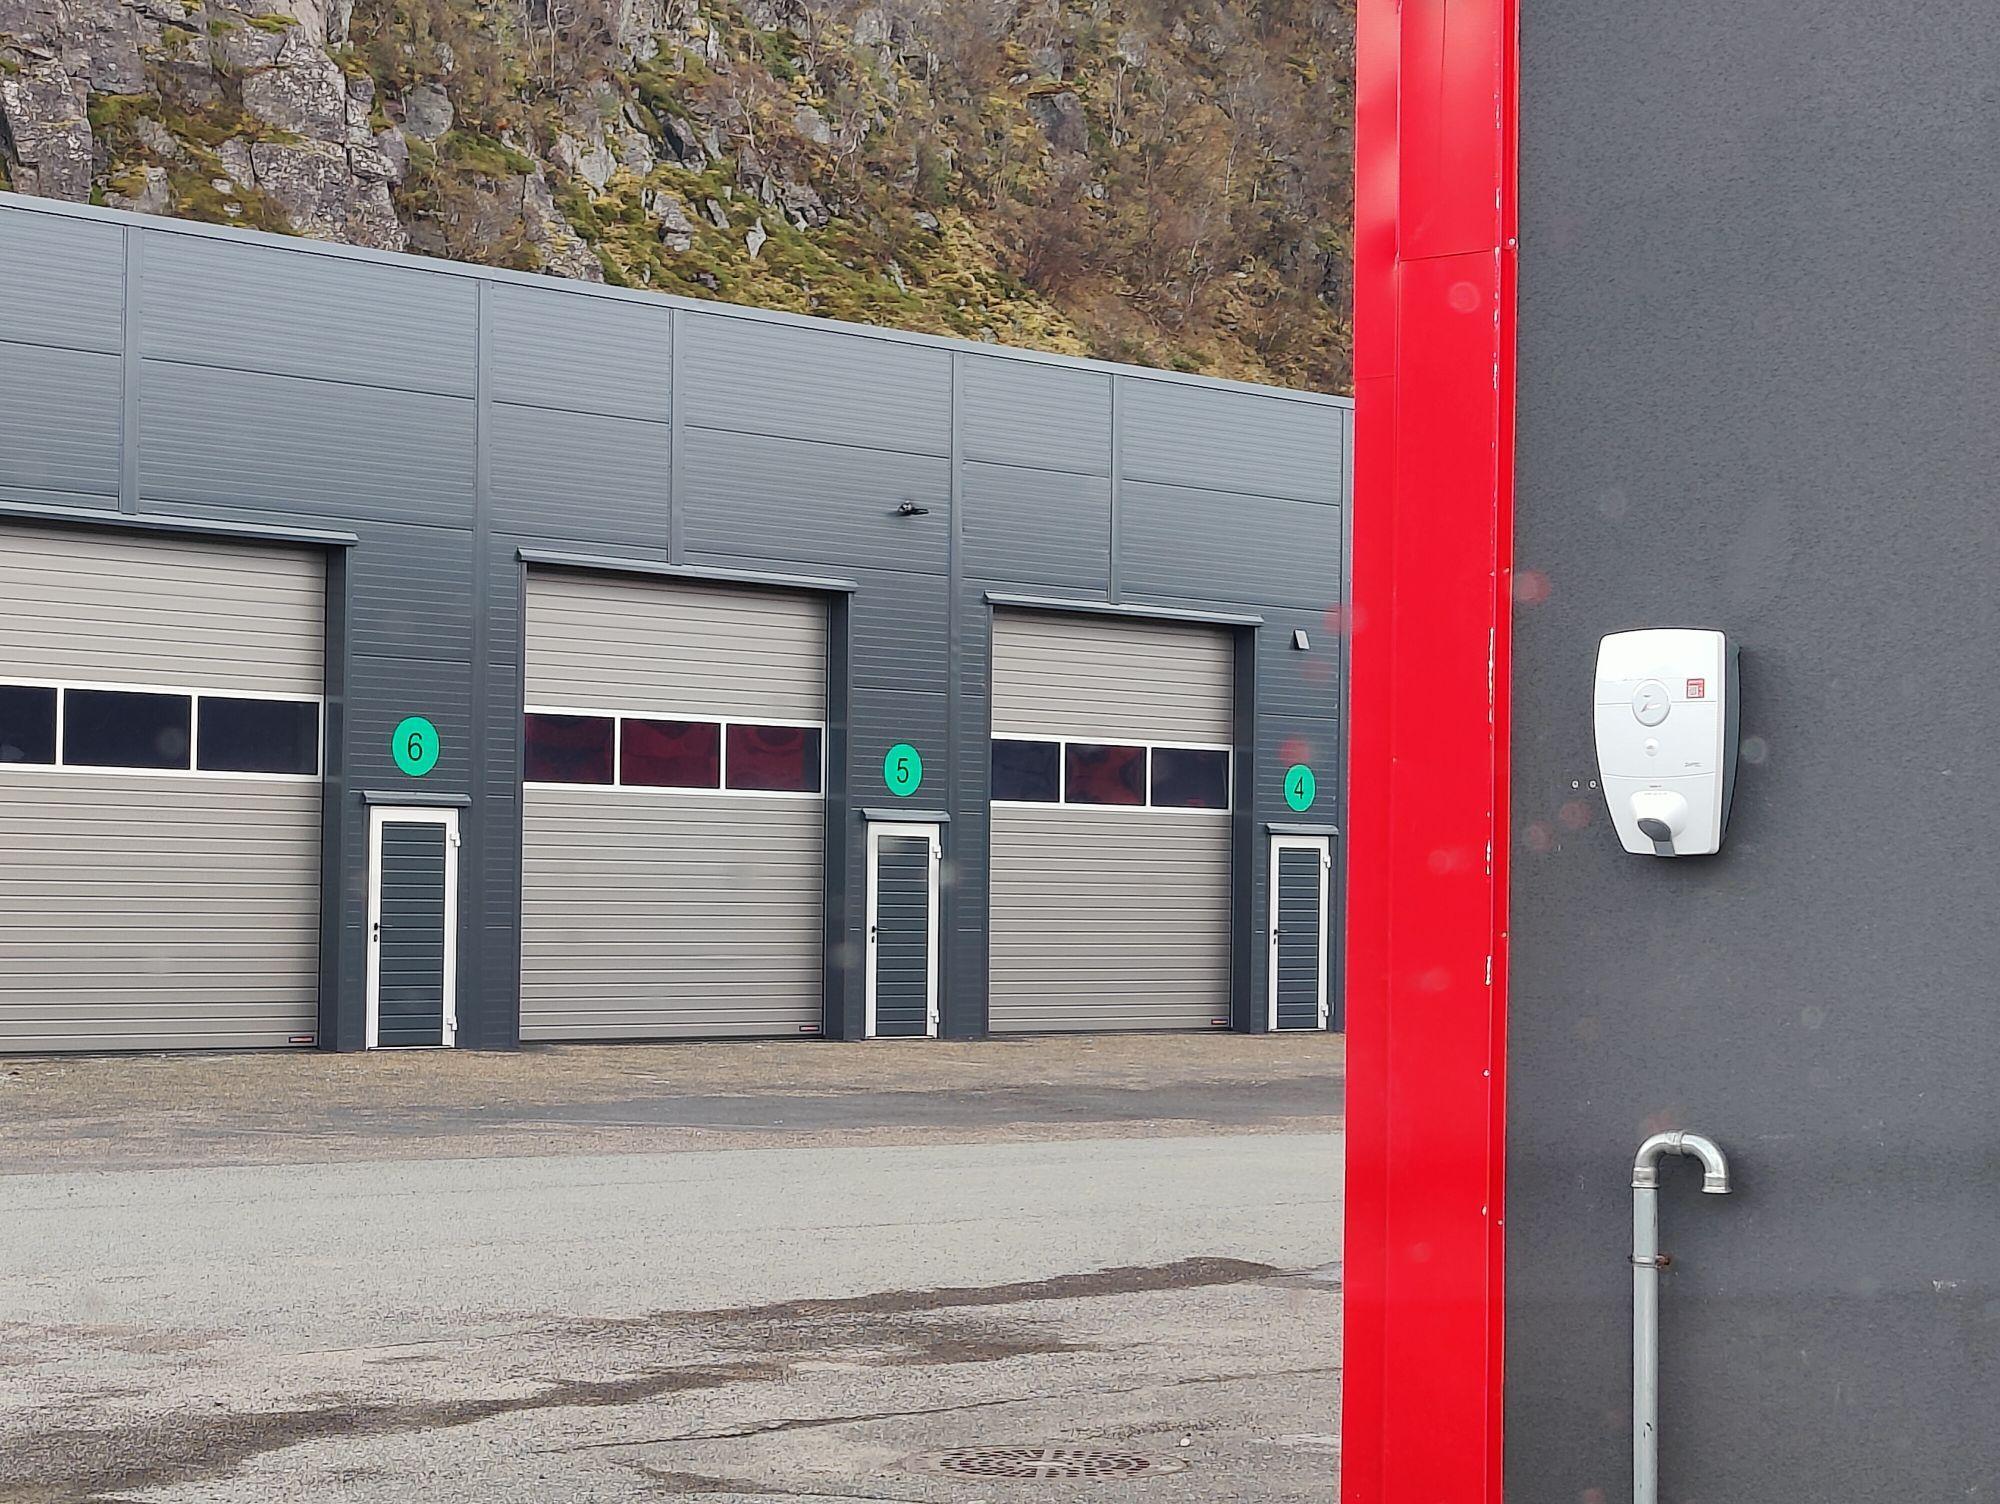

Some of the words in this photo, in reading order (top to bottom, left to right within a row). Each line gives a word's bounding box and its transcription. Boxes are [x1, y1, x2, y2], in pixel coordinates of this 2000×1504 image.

[407, 732, 423, 761] 6
[896, 757, 909, 784] 5
[1293, 776, 1304, 800] 4
